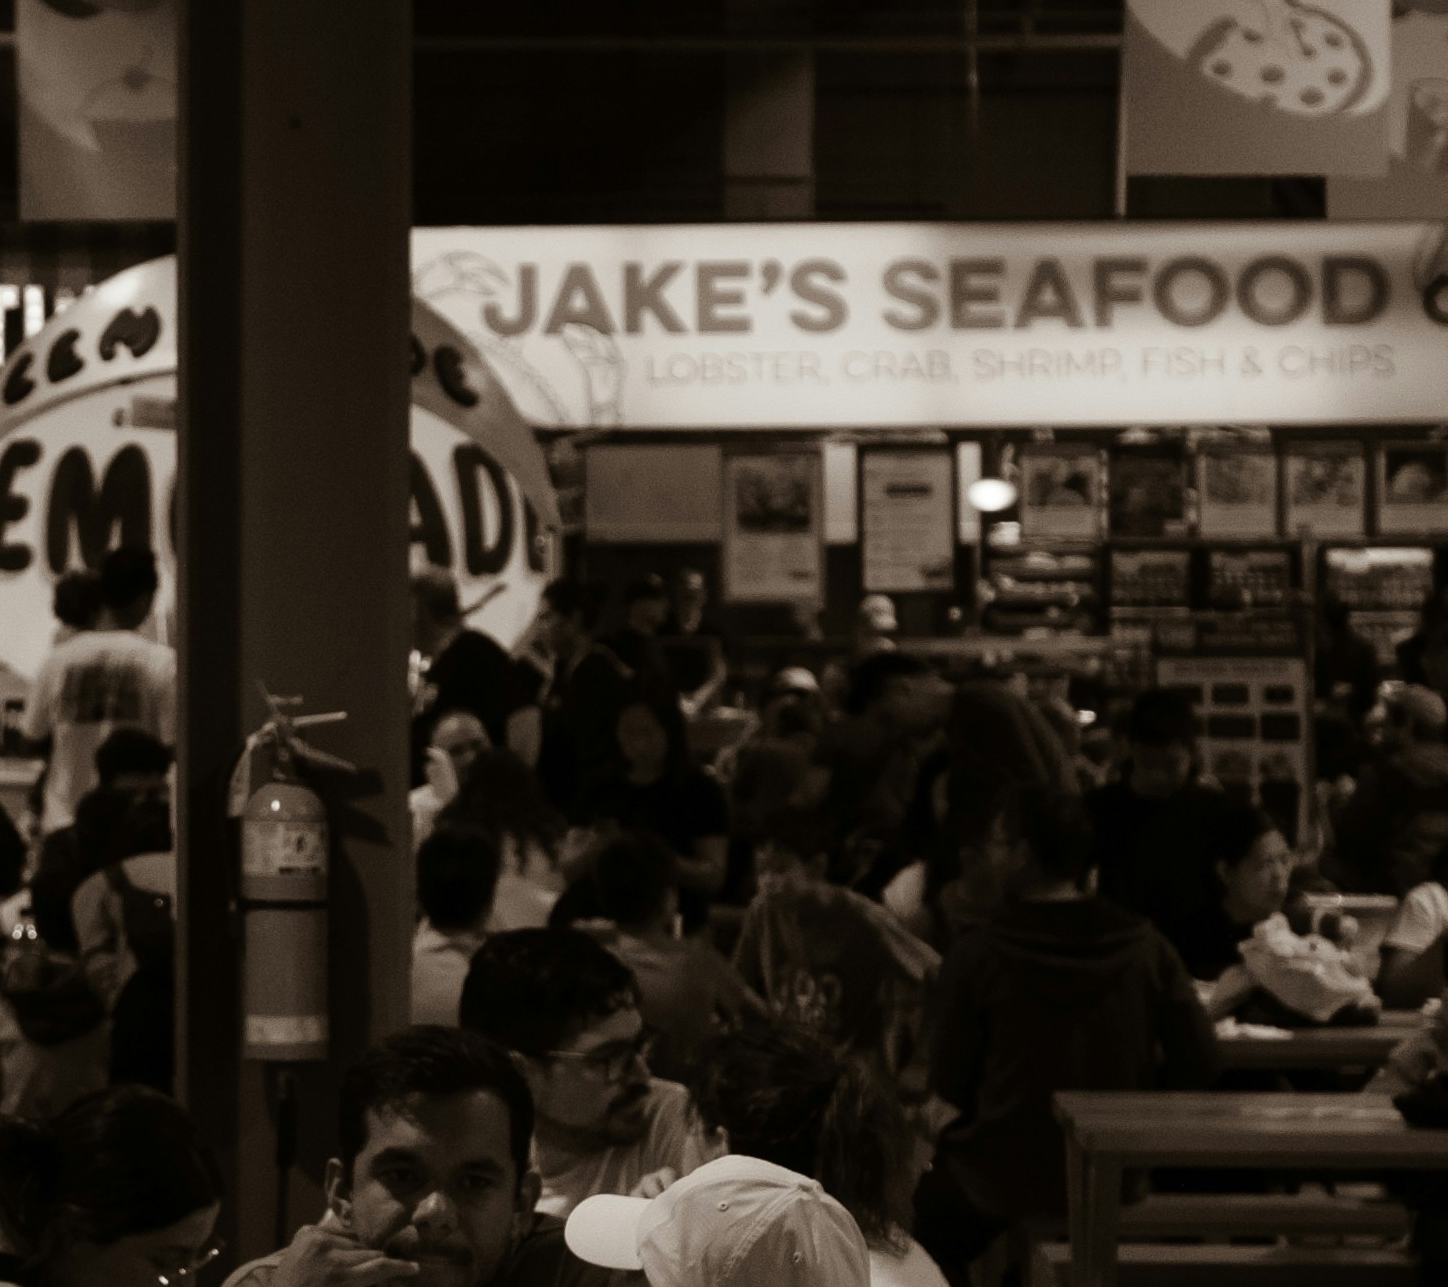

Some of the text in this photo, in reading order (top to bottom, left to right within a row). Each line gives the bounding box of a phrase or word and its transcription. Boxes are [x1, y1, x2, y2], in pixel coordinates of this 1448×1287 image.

[482, 258, 850, 337] JAKE'S
[882, 255, 1390, 333] SEAFOOD
[1141, 346, 1226, 381] FISH
[1240, 347, 1264, 378] &
[1278, 343, 1397, 382] CHIPS
